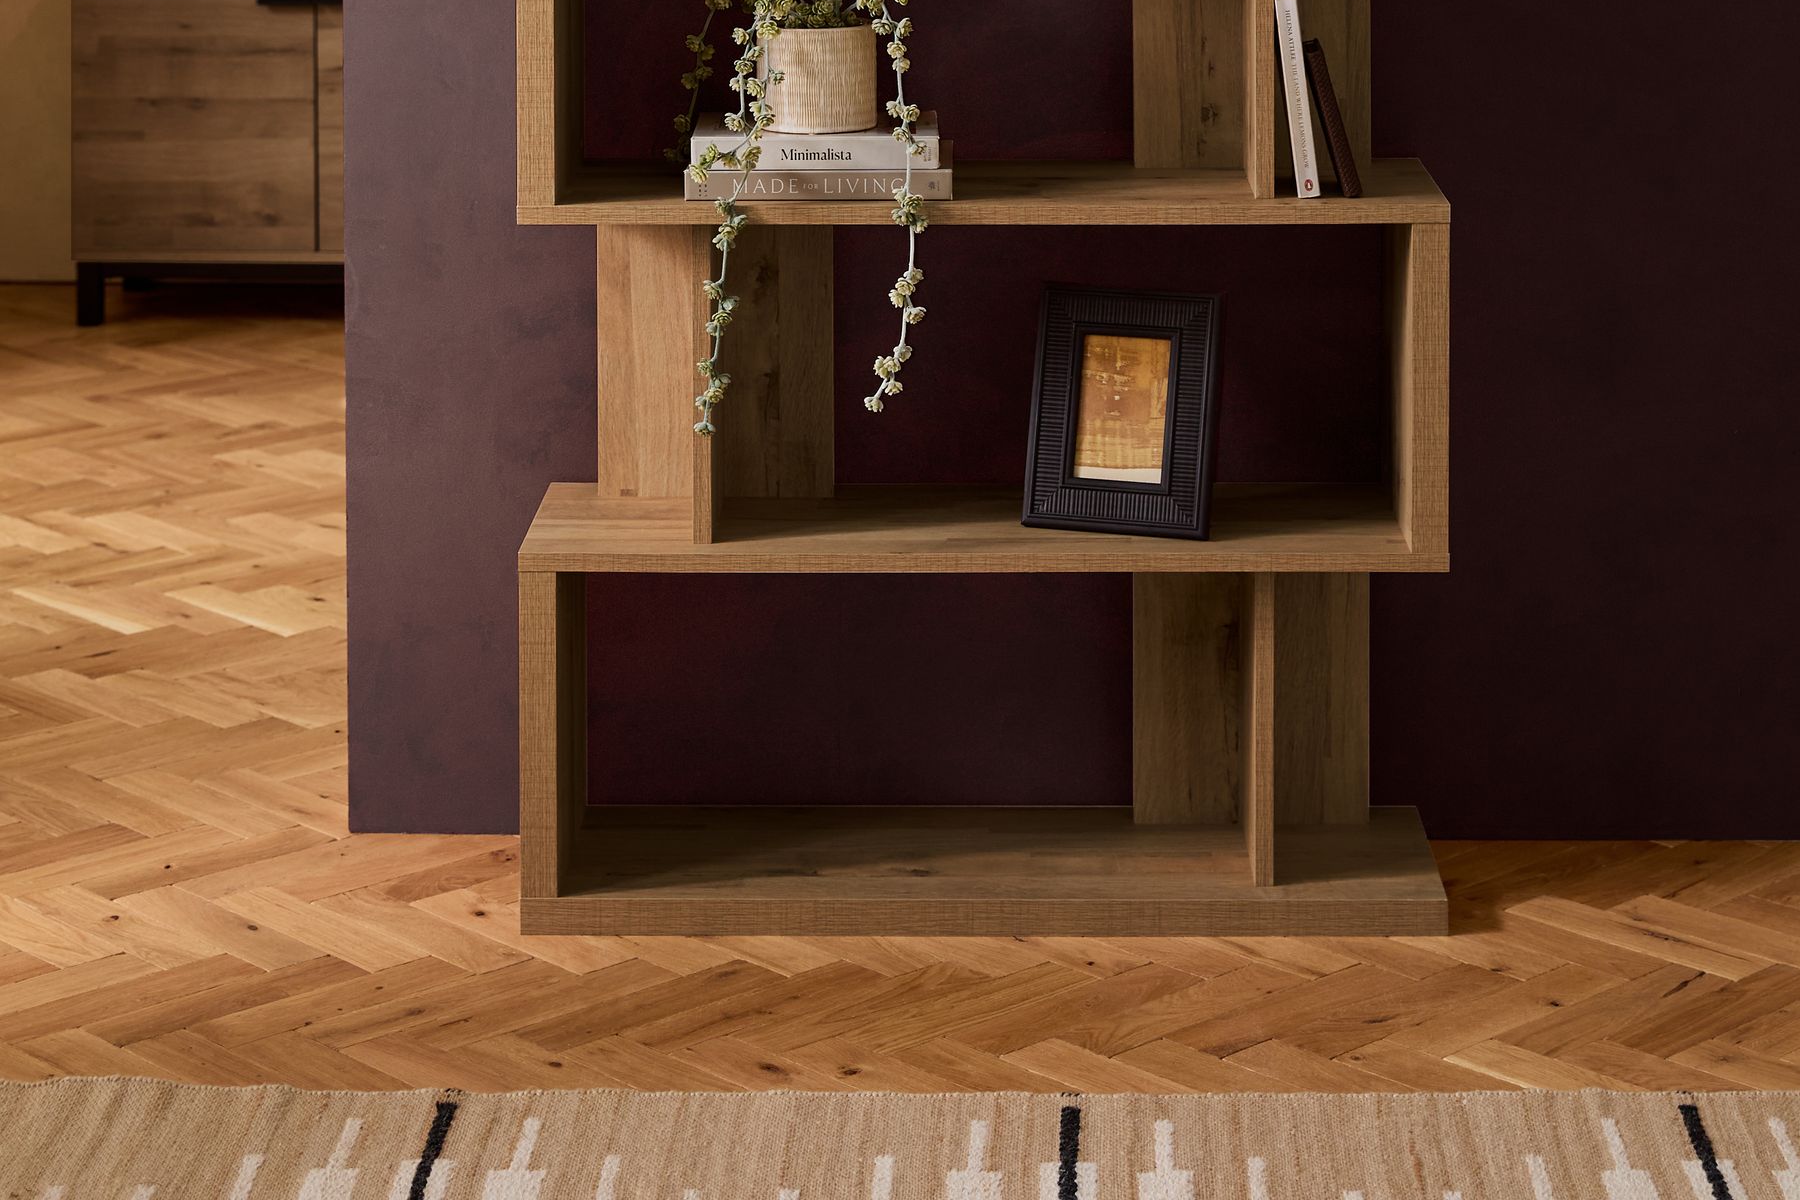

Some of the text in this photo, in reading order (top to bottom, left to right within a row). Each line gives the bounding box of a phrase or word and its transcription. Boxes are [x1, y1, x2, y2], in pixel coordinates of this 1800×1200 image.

[1284, 9, 1293, 36] HELENA
[1288, 37, 1296, 60] ATTLEE
[781, 148, 852, 161] Minimalista
[733, 178, 799, 194] MADE
[823, 178, 904, 194] LIVING
